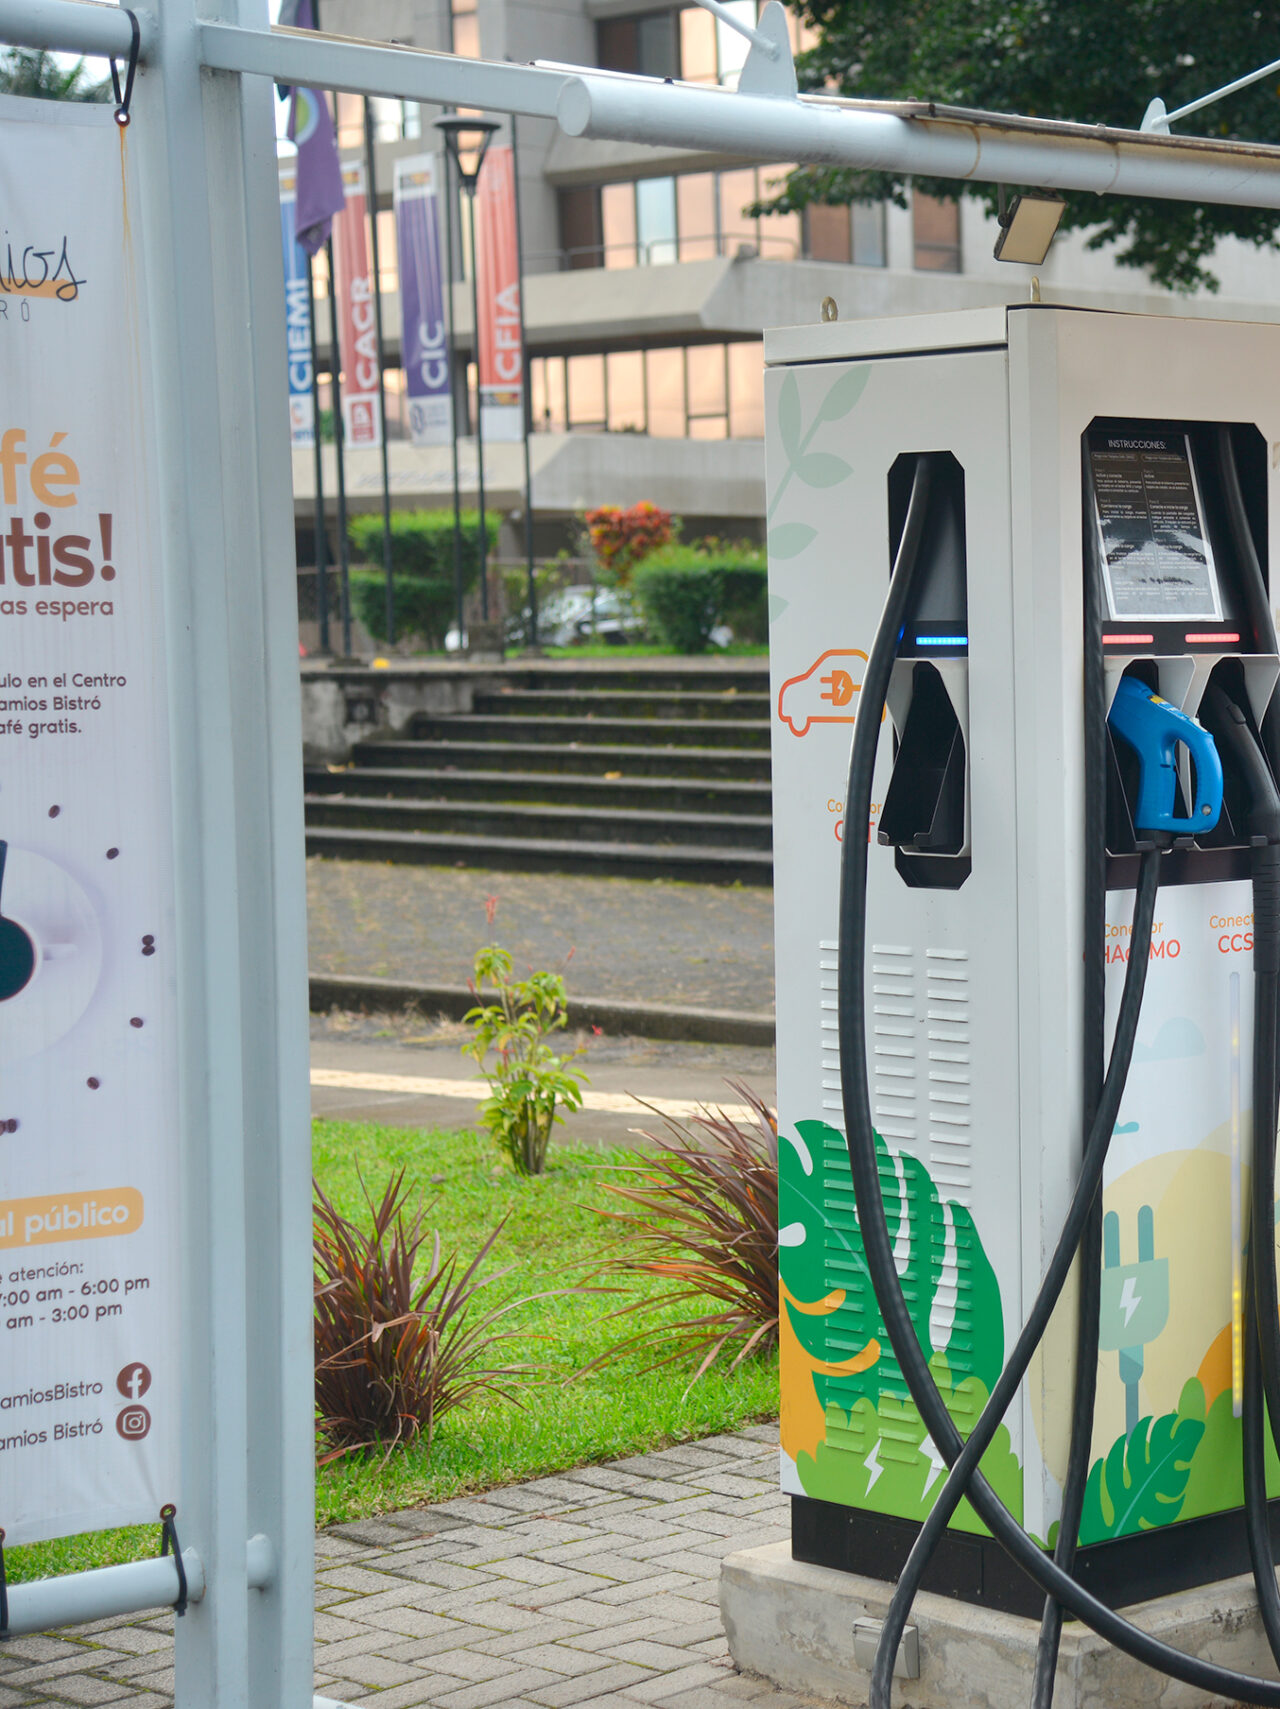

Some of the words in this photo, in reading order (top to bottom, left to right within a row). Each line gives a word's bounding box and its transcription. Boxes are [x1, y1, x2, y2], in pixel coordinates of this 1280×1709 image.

[0, 230, 87, 302] ios
[286, 278, 313, 391] CIEMI
[350, 277, 377, 389] CACR
[493, 281, 522, 381] CFIA
[418, 320, 449, 389] CIC
[0, 511, 117, 588] tis!
[35, 599, 115, 622] espera
[28, 677, 48, 688] en
[53, 673, 67, 688] el
[72, 673, 127, 687] Centro
[53, 695, 102, 711] Bistró
[28, 718, 82, 739] gratis.
[1217, 932, 1255, 954] CCS
[25, 1201, 129, 1242] público
[8, 1261, 84, 1283] atención:
[36, 1288, 63, 1302] am
[81, 1278, 120, 1296] 6:00
[124, 1278, 150, 1296] pm
[6, 1315, 33, 1330] am
[51, 1304, 90, 1323] 3:00
[95, 1303, 123, 1322] pm
[53, 1418, 104, 1441] Bistró
